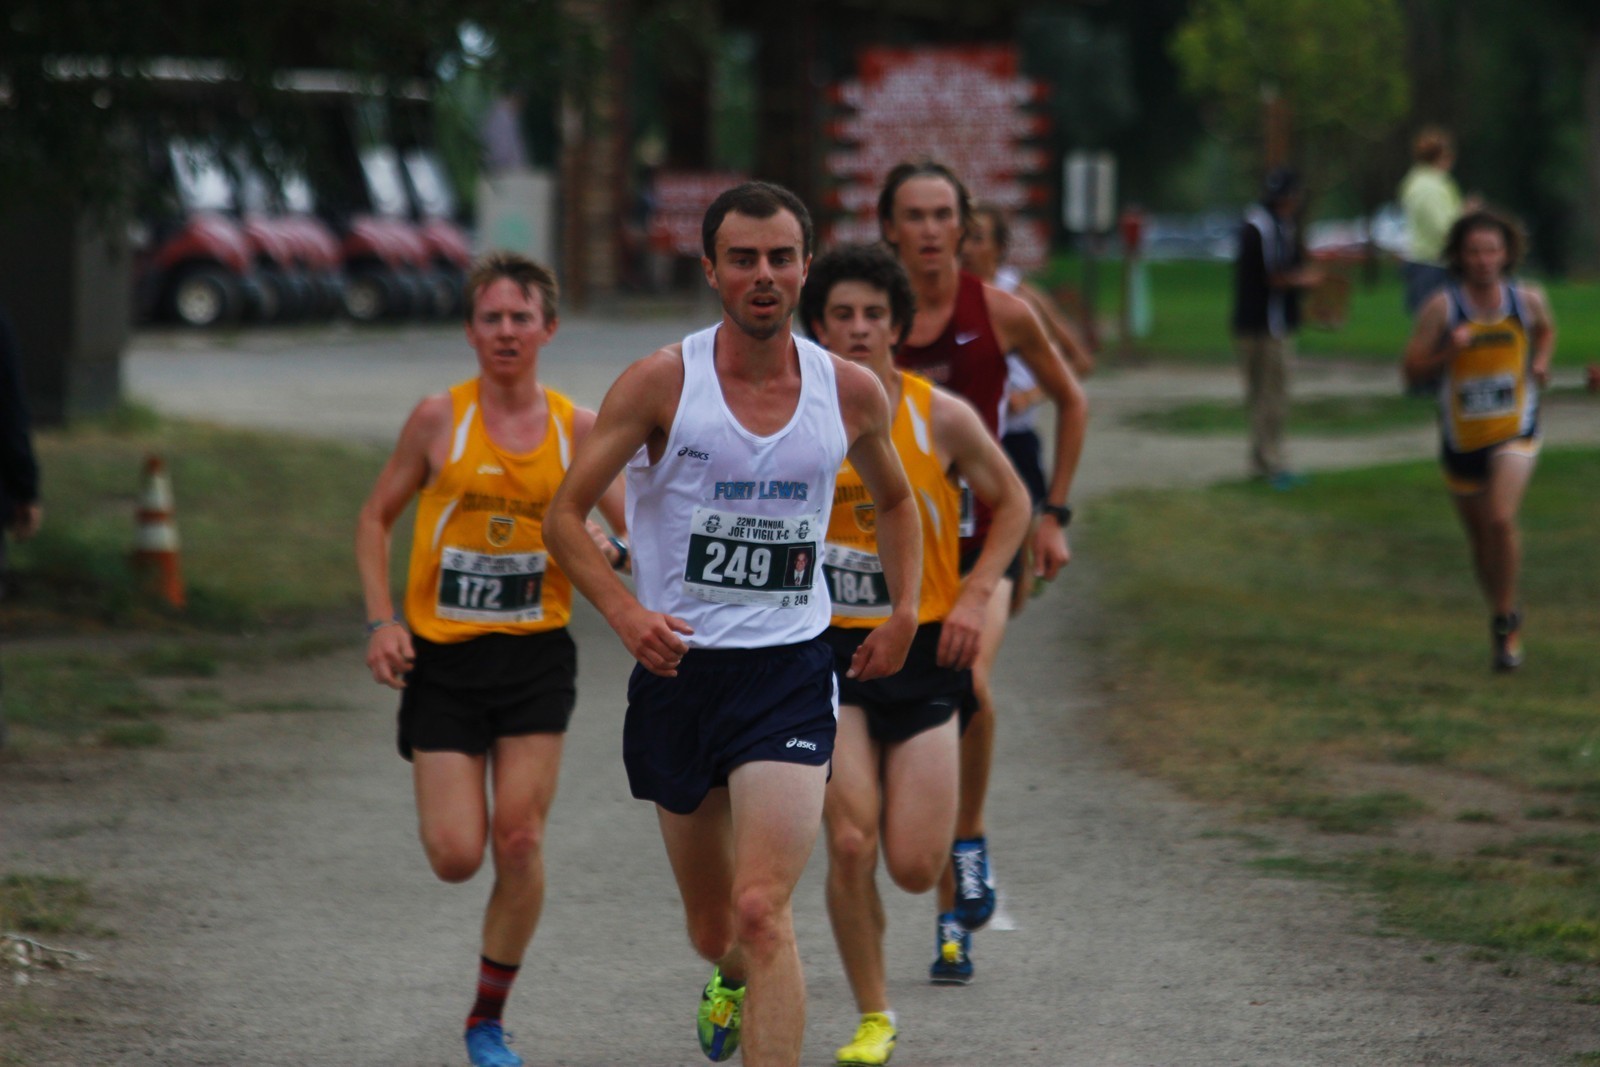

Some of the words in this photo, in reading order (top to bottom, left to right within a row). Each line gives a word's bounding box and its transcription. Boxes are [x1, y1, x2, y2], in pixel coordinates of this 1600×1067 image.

[714, 481, 756, 500] FORT
[758, 480, 809, 501] LEWIS
[728, 526, 745, 538] JOE
[746, 527, 751, 539] I
[752, 528, 774, 541] VIGIL
[776, 529, 790, 540] X-C
[737, 517, 756, 528] 22ND
[757, 519, 784, 529] ANNUAL
[702, 541, 772, 587] 249
[457, 574, 503, 609] 172
[832, 570, 877, 604] 184
[794, 595, 808, 606] 249
